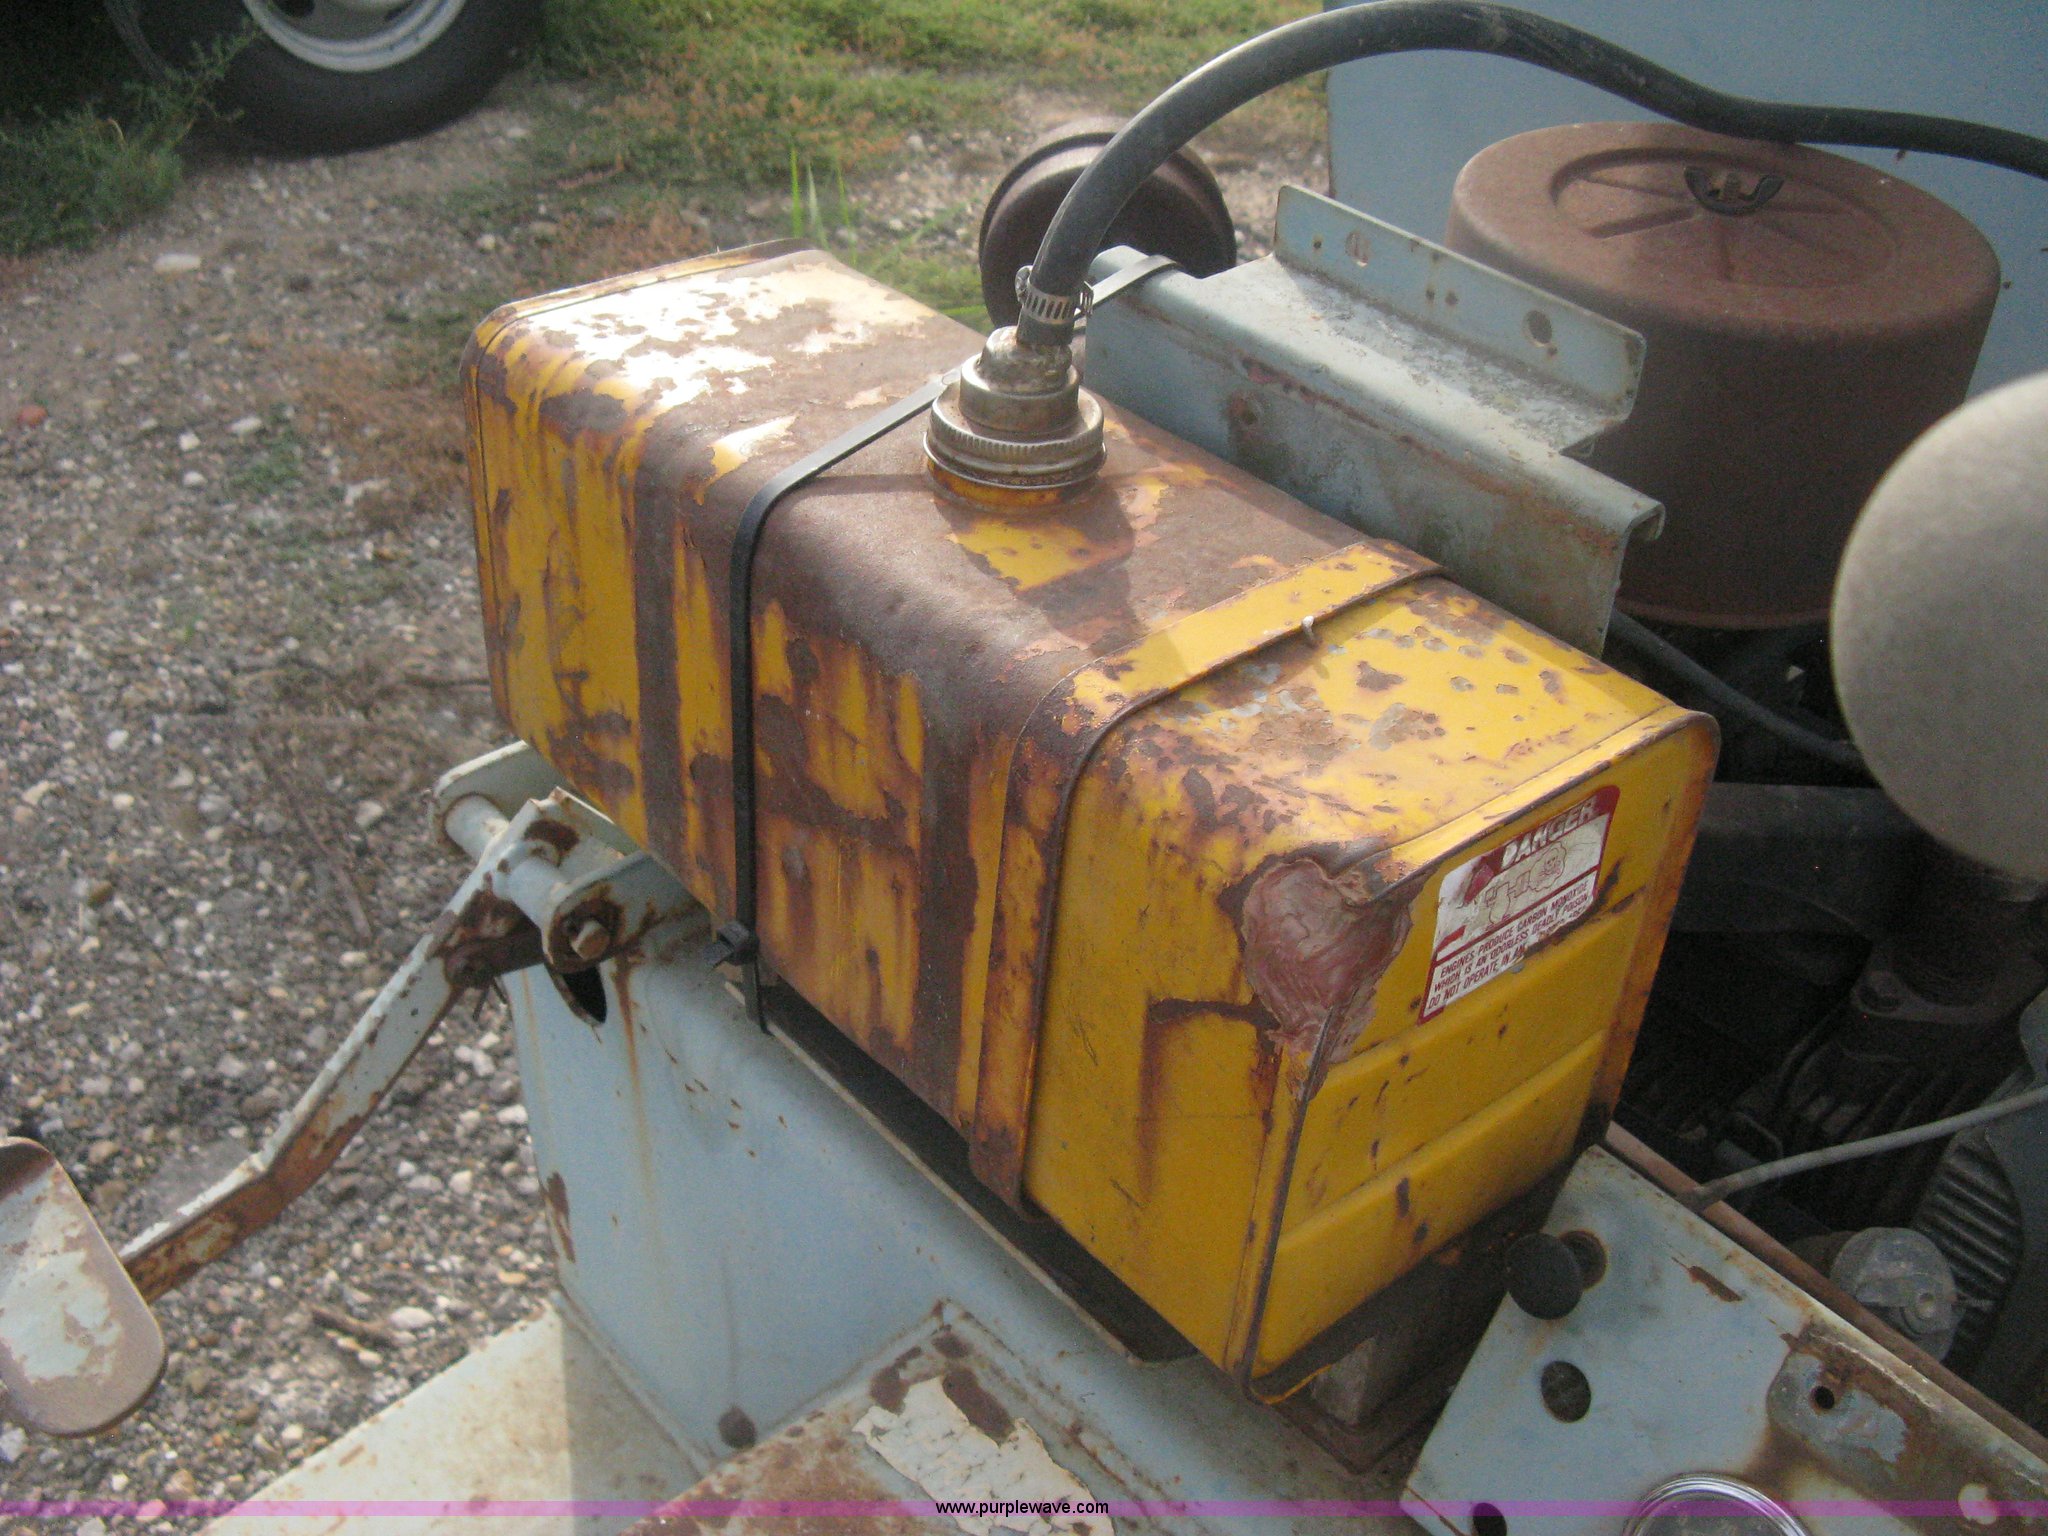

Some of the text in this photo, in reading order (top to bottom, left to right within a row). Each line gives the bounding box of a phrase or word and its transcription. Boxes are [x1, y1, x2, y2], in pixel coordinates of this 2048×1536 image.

[1502, 804, 1594, 868] DANGER
[1434, 970, 1461, 993] WHICH
[1464, 962, 1473, 975] IS
[1475, 953, 1488, 969] AN
[1490, 930, 1528, 959] ODORLESS
[1532, 910, 1560, 935] DEADLY
[1562, 894, 1589, 915] POISON
[1441, 949, 1475, 978] ENGINES
[1478, 929, 1513, 953] PRODUCE
[1517, 910, 1547, 930] CARBON
[1552, 881, 1589, 911] MONOXIDE
[1427, 996, 1440, 1009] DO
[1443, 983, 1459, 1002] NOT
[1463, 964, 1499, 988] OPERATE
[1501, 956, 1511, 969] IN
